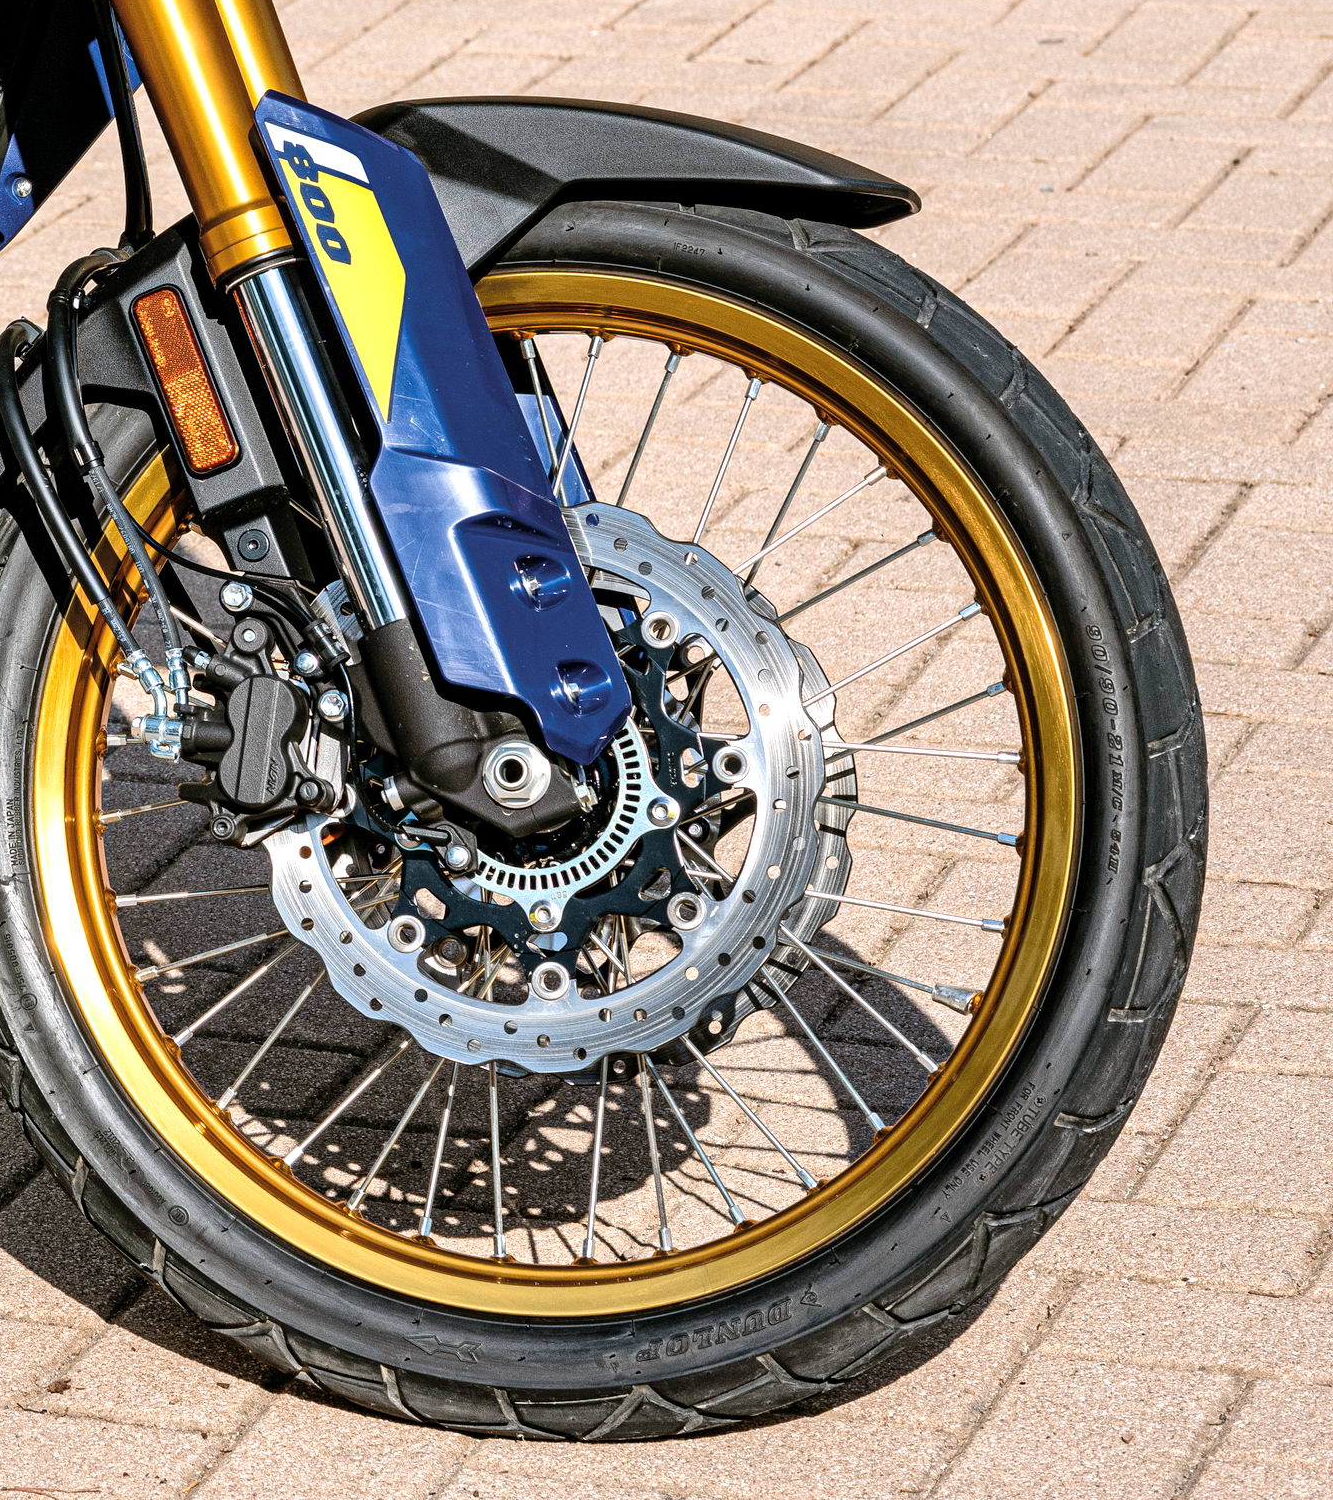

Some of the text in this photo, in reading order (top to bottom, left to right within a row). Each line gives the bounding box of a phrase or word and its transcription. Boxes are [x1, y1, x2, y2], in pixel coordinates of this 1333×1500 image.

[276, 140, 352, 266] 800
[5, 798, 19, 866] MADE IN JAPAN
[13, 795, 21, 826] RUBBER
[942, 1081, 1037, 1200] FOR FRONT WHEEL USE ONLY
[988, 1104, 1043, 1178] TUBE TYPE
[634, 1295, 794, 1364] DUNLOP
